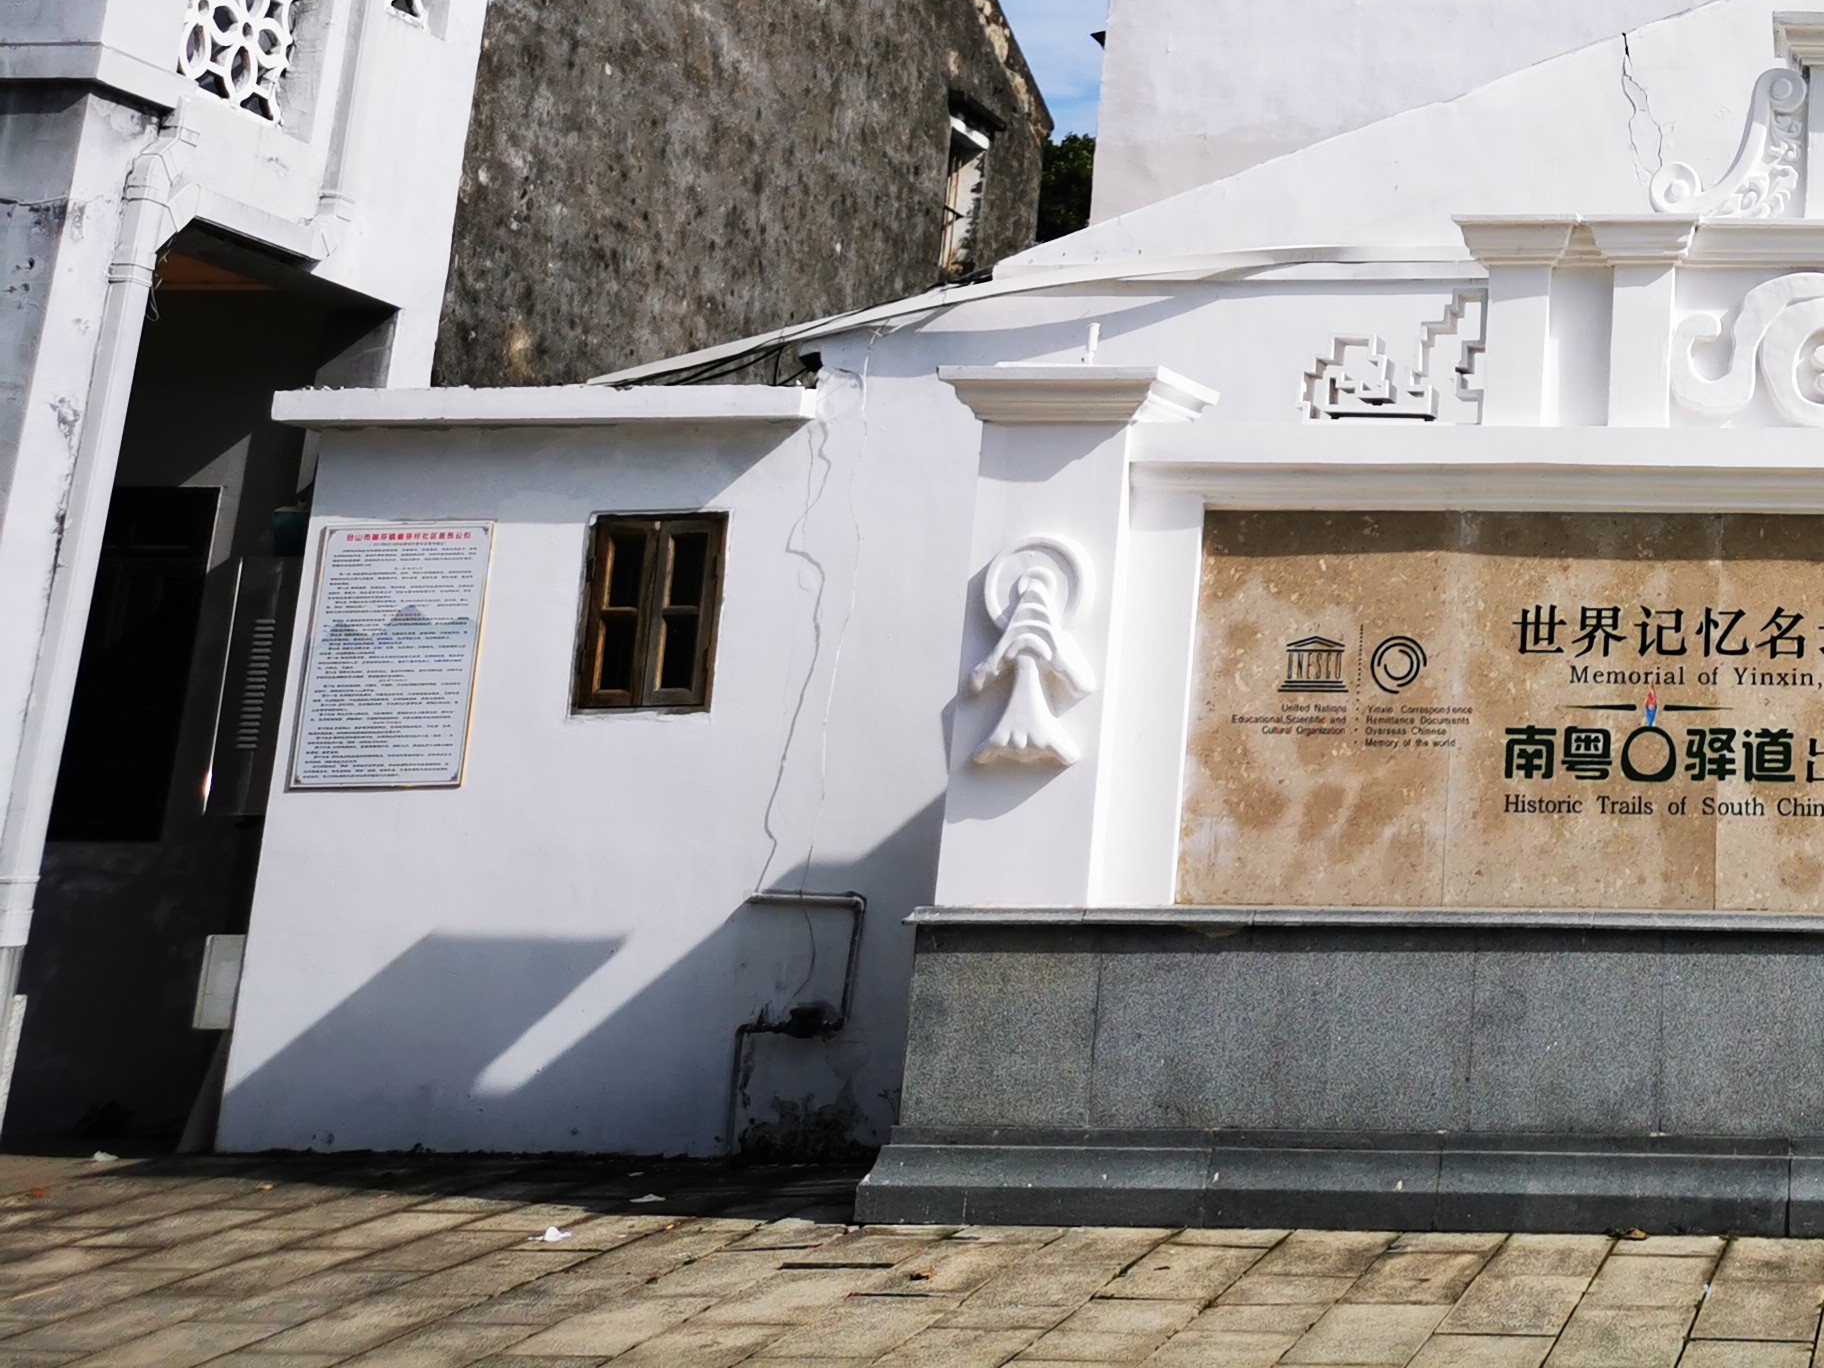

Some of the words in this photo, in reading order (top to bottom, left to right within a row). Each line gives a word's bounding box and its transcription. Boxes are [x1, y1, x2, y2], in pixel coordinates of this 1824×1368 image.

[1286, 651, 1343, 680] UNESCO
[1570, 665, 1685, 686] Memorial
[1699, 665, 1719, 686] of
[1734, 666, 1824, 689] Yinxin,
[1281, 703, 1311, 713] United
[1314, 704, 1347, 713] Nations
[1330, 715, 1347, 724] and
[1420, 716, 1470, 725] Documents
[1261, 725, 1292, 735] Cultural
[1503, 793, 1583, 815] Historic
[1597, 794, 1654, 816] Trails
[1667, 795, 1688, 816] of
[1702, 796, 1765, 817] South
